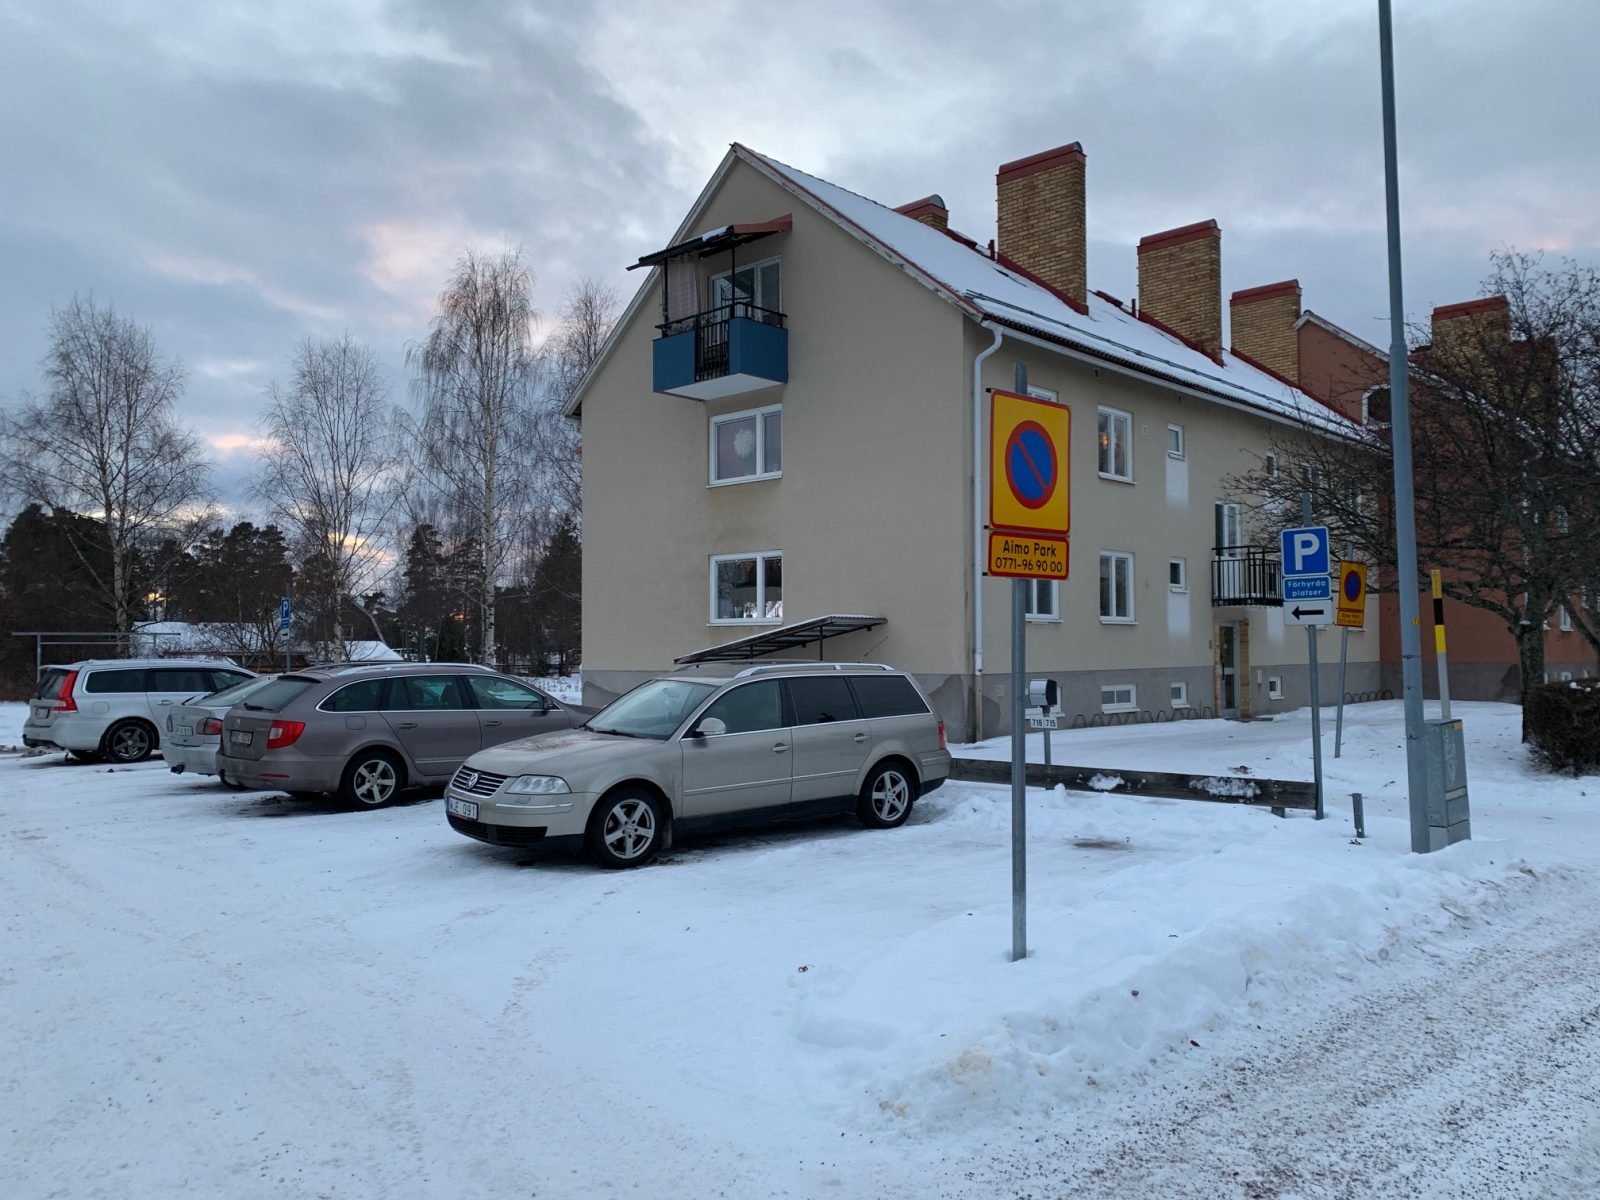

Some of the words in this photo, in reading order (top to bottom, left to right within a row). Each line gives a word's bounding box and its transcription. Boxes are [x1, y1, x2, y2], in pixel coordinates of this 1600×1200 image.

[1002, 540, 1030, 555] Aimo
[1033, 543, 1057, 558] Park
[1294, 533, 1320, 571] P
[995, 556, 1034, 571] 0771-96
[1035, 560, 1048, 572] 90
[1050, 561, 1063, 573] 00
[1287, 578, 1326, 589] Förhyrda
[1292, 589, 1322, 598] platser
[282, 600, 289, 617] P
